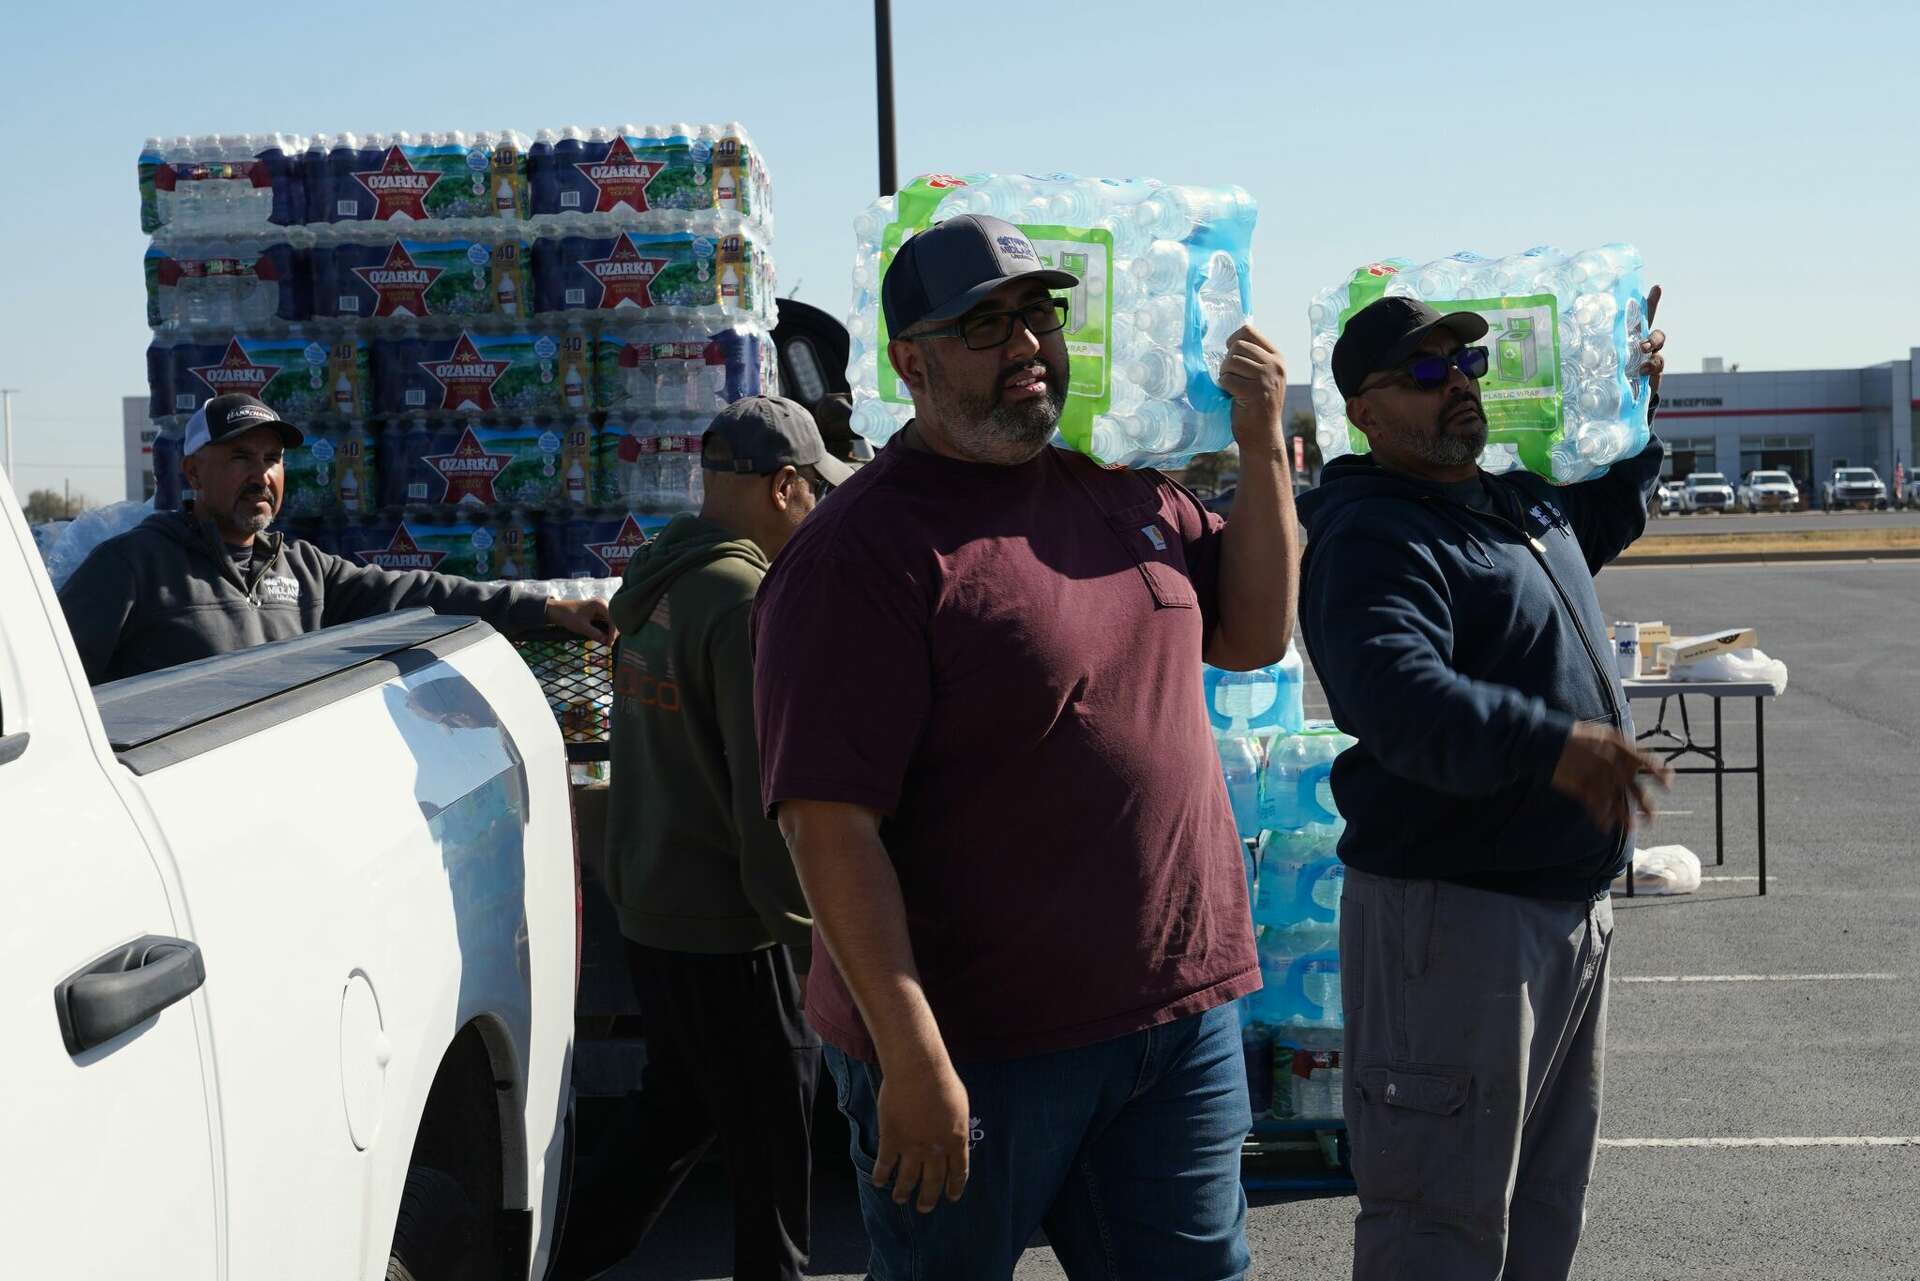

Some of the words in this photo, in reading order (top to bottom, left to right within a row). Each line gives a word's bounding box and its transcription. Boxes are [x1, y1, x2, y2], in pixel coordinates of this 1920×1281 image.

[719, 140, 736, 154] 40
[496, 150, 512, 164] 40
[590, 165, 651, 179] OZARKA
[368, 175, 428, 189] OZARKA
[722, 237, 739, 251] 40
[594, 261, 655, 276] OZARKA
[369, 270, 429, 284] OZARKA
[563, 337, 581, 351] 40
[206, 368, 266, 382] OZARKA
[436, 364, 496, 378] OZARKA
[567, 432, 585, 446] 40
[439, 458, 499, 471] OZARKA
[373, 554, 434, 568] OZARKA
